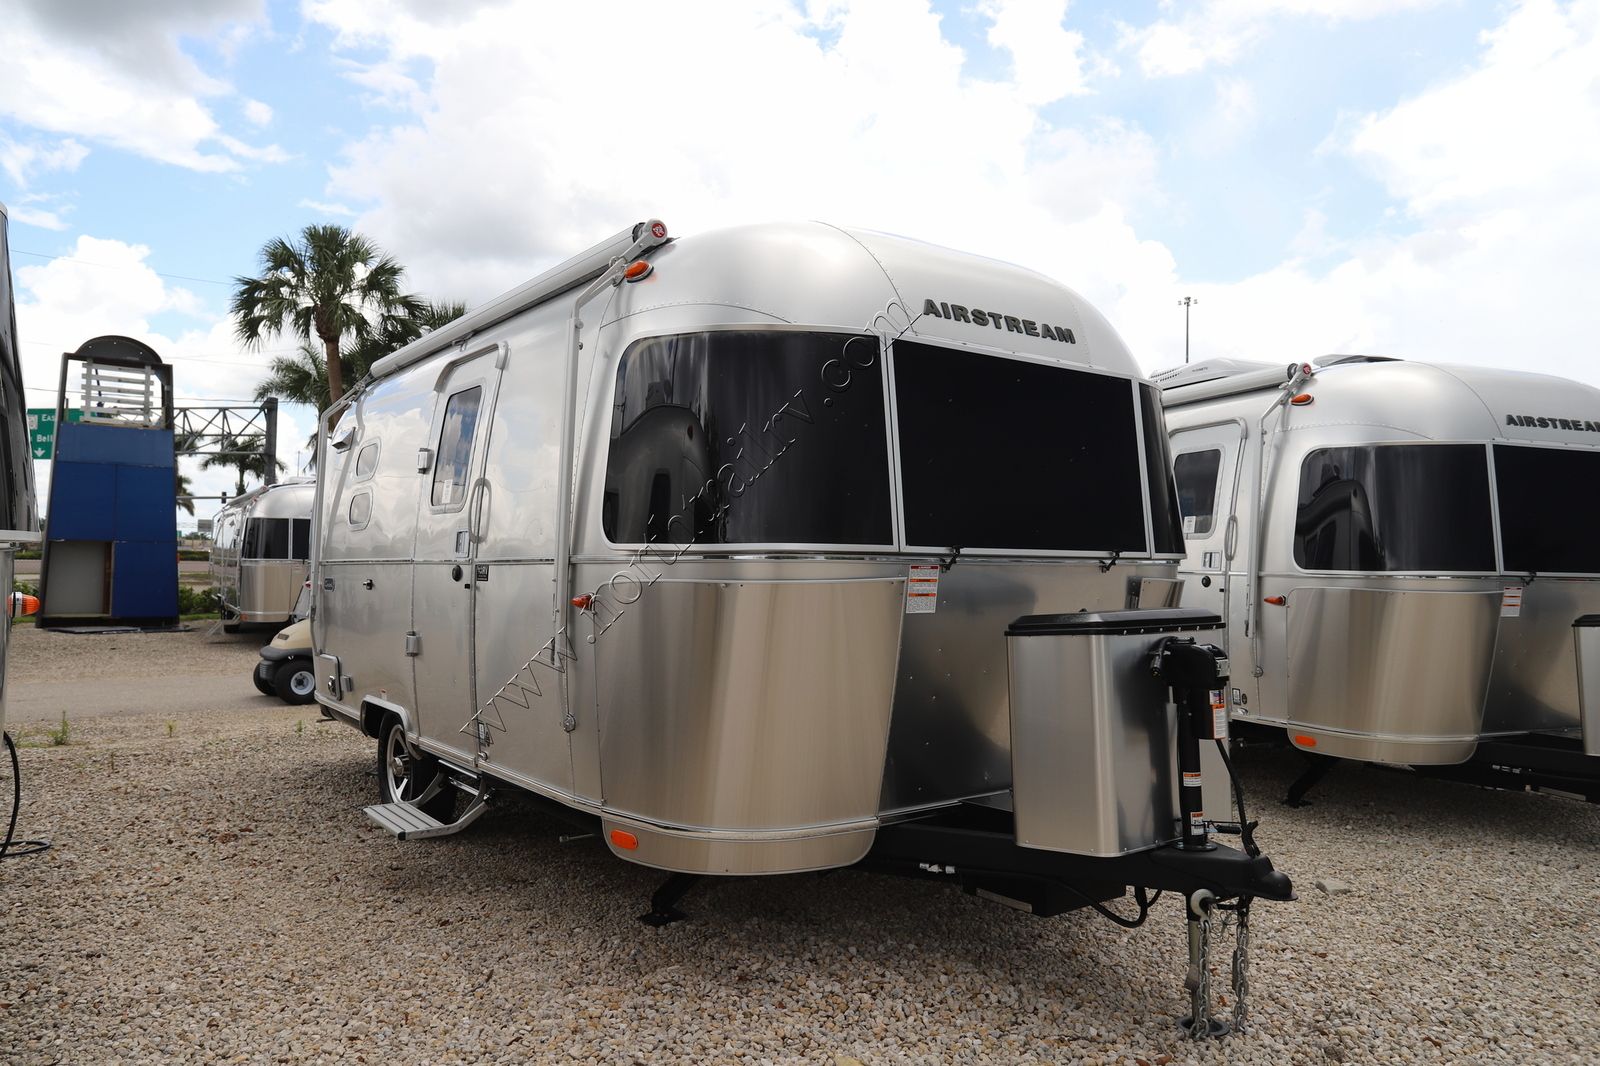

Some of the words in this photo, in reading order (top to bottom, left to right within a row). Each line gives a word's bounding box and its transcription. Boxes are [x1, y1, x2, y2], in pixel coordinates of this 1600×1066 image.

[923, 298, 1076, 345] AIRSTREAM
[41, 414, 56, 422] EAS
[36, 434, 53, 443] Bell
